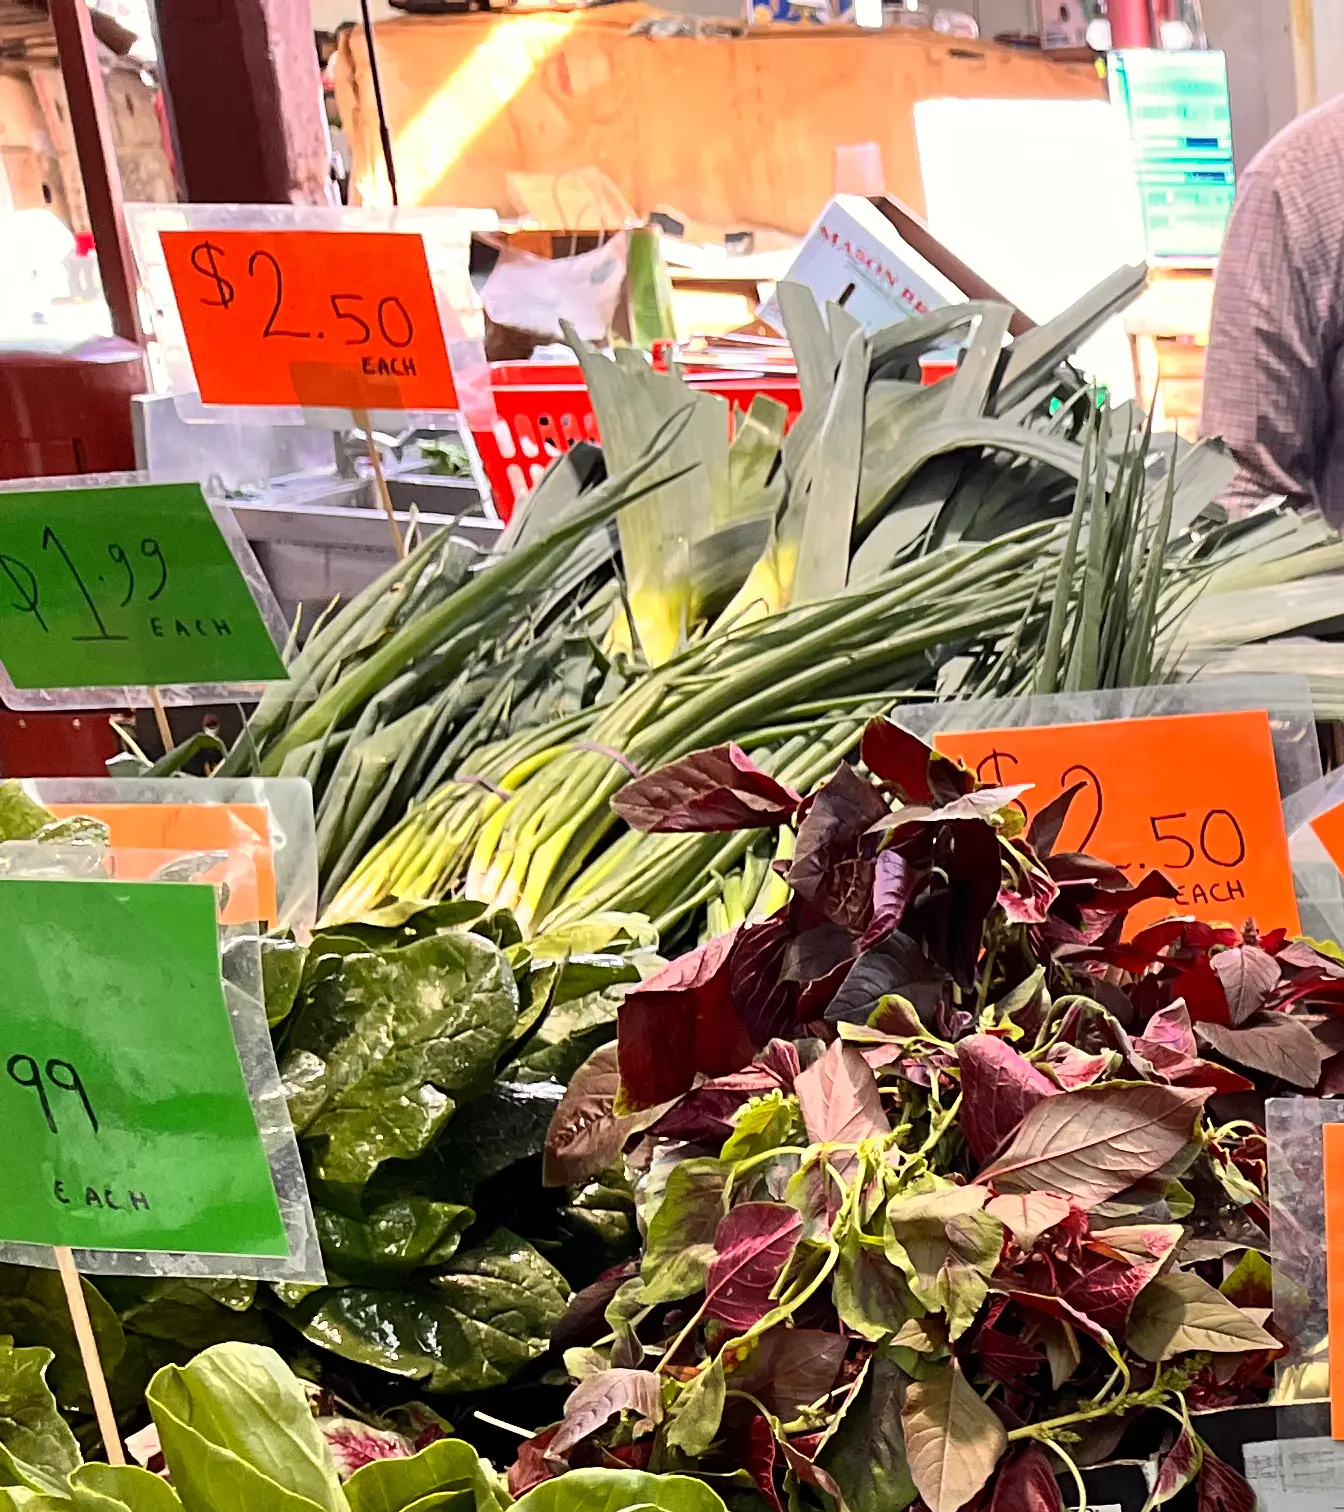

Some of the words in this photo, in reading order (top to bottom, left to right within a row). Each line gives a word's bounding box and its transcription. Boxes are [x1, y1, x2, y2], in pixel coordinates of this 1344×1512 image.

[362, 357, 417, 376] EACH
[151, 616, 232, 638] EACH
[1174, 879, 1245, 906] EACH
[54, 1180, 150, 1211] EACH
